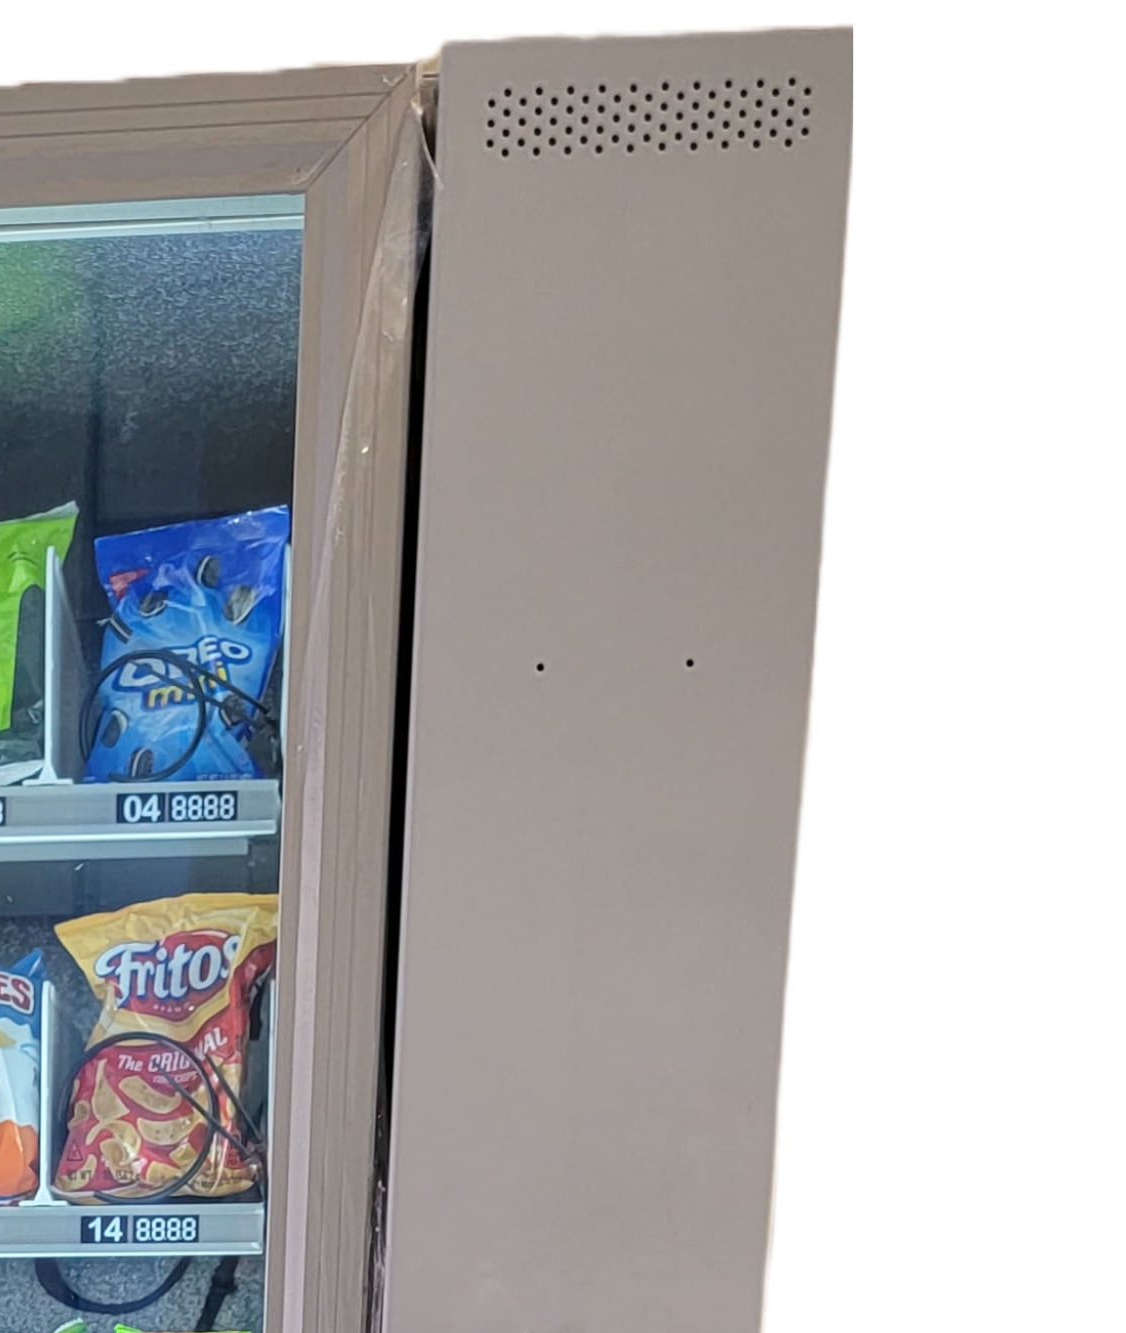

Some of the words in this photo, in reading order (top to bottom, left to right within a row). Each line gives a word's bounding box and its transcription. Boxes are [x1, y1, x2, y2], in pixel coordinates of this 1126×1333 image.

[123, 796, 160, 821] 04
[118, 1054, 143, 1072] The
[88, 1218, 122, 1241] 14
